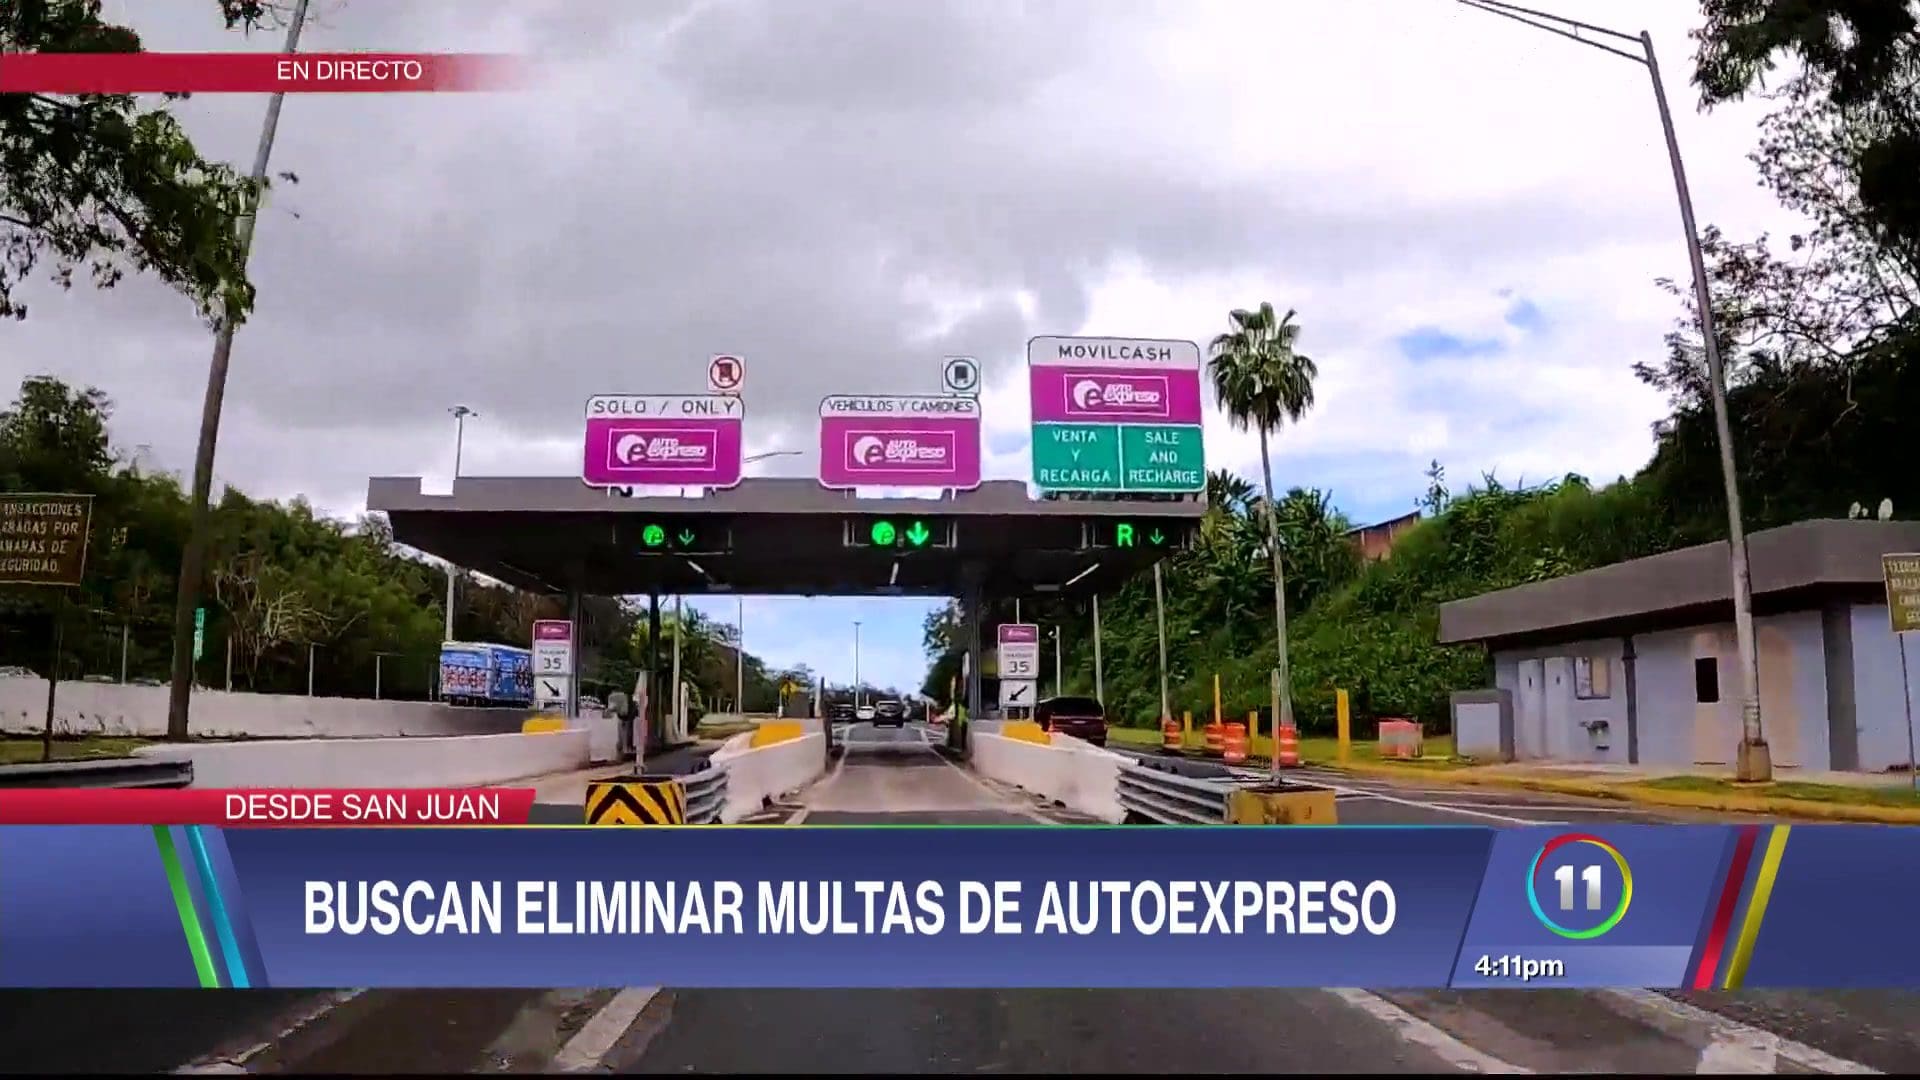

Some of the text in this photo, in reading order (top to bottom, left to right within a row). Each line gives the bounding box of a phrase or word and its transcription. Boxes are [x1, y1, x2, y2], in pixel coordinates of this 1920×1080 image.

[1058, 345, 1172, 361] MOVILCASH
[594, 400, 647, 414] SOLO
[682, 400, 736, 414] ONLY
[899, 400, 908, 411] Y
[911, 400, 974, 413] CAMIONES
[1053, 430, 1098, 443] VENTA
[1145, 432, 1180, 444] SALE
[1071, 449, 1081, 462] Y
[1150, 451, 1178, 464] AND
[1040, 468, 1112, 482] RECARGA
[1129, 469, 1200, 484] RECHARGE
[54, 521, 79, 535] POR
[1117, 523, 1133, 547] R
[51, 540, 67, 554] DE
[543, 656, 562, 670] 35
[1008, 660, 1030, 673] 35
